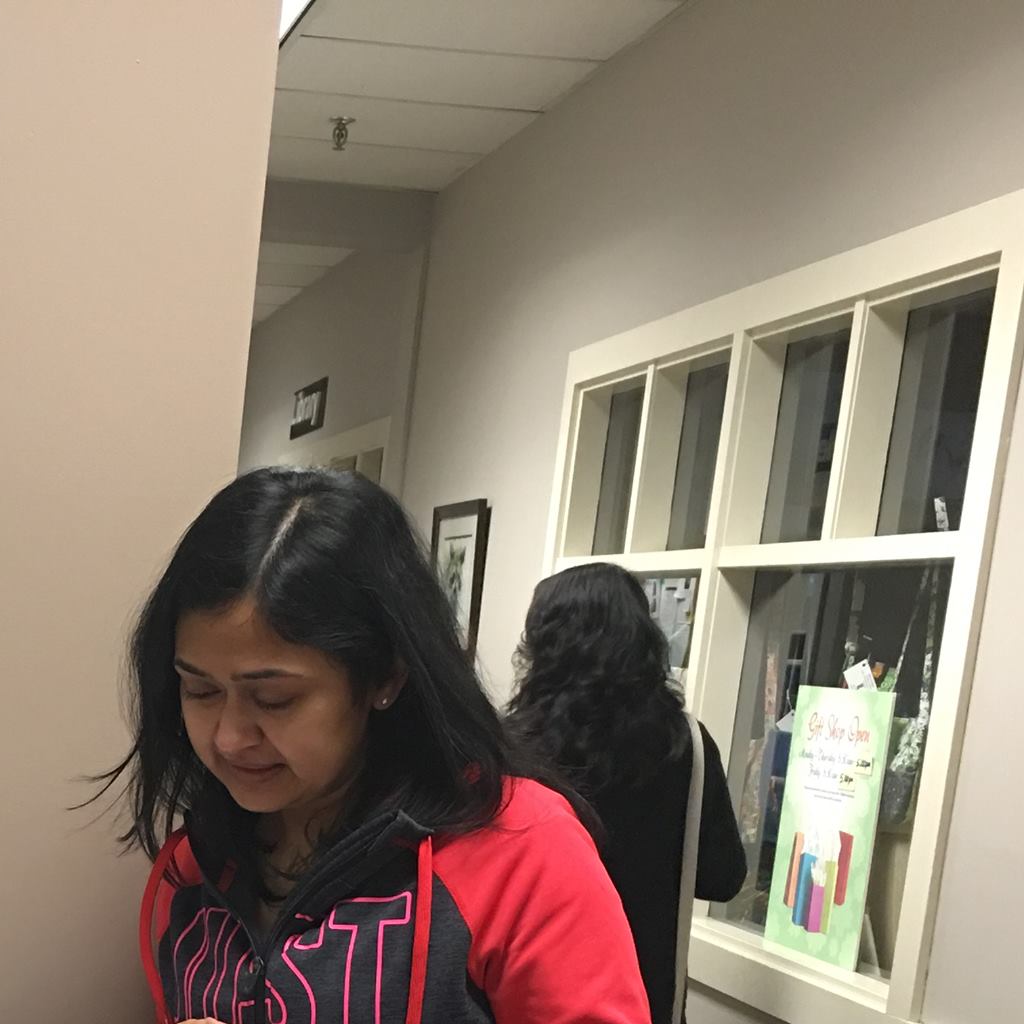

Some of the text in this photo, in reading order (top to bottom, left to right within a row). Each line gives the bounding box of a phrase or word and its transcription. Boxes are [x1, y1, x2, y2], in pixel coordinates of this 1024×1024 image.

[807, 712, 871, 747] Gift Shop Open
